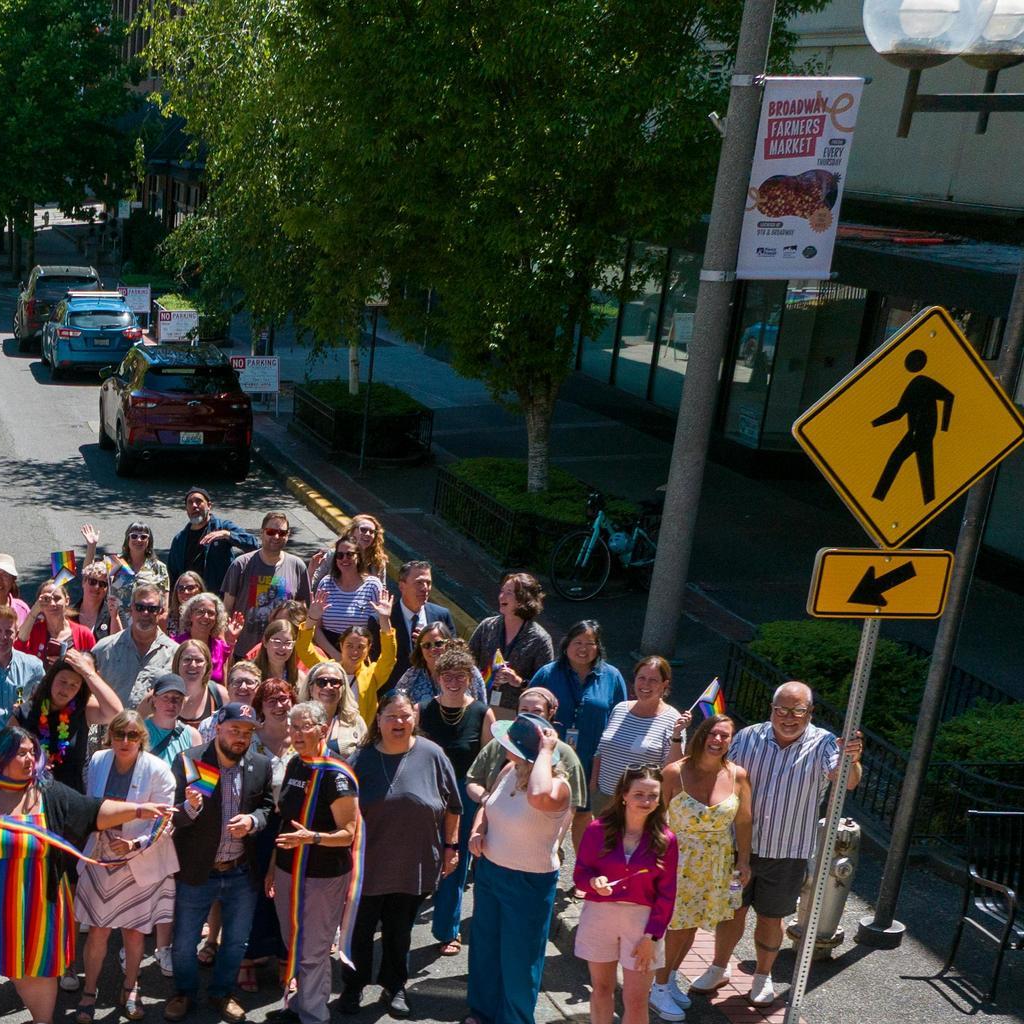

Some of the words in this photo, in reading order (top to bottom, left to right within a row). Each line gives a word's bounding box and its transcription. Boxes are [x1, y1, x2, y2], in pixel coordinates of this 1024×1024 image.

[768, 97, 828, 116] BROADWAY
[771, 118, 820, 137] FARMERS
[769, 137, 813, 155] MARKET
[823, 146, 845, 158] EVERY
[161, 312, 171, 321] NO
[173, 312, 196, 320] PARKING
[232, 359, 244, 369] NO
[247, 359, 277, 368] PARKING
